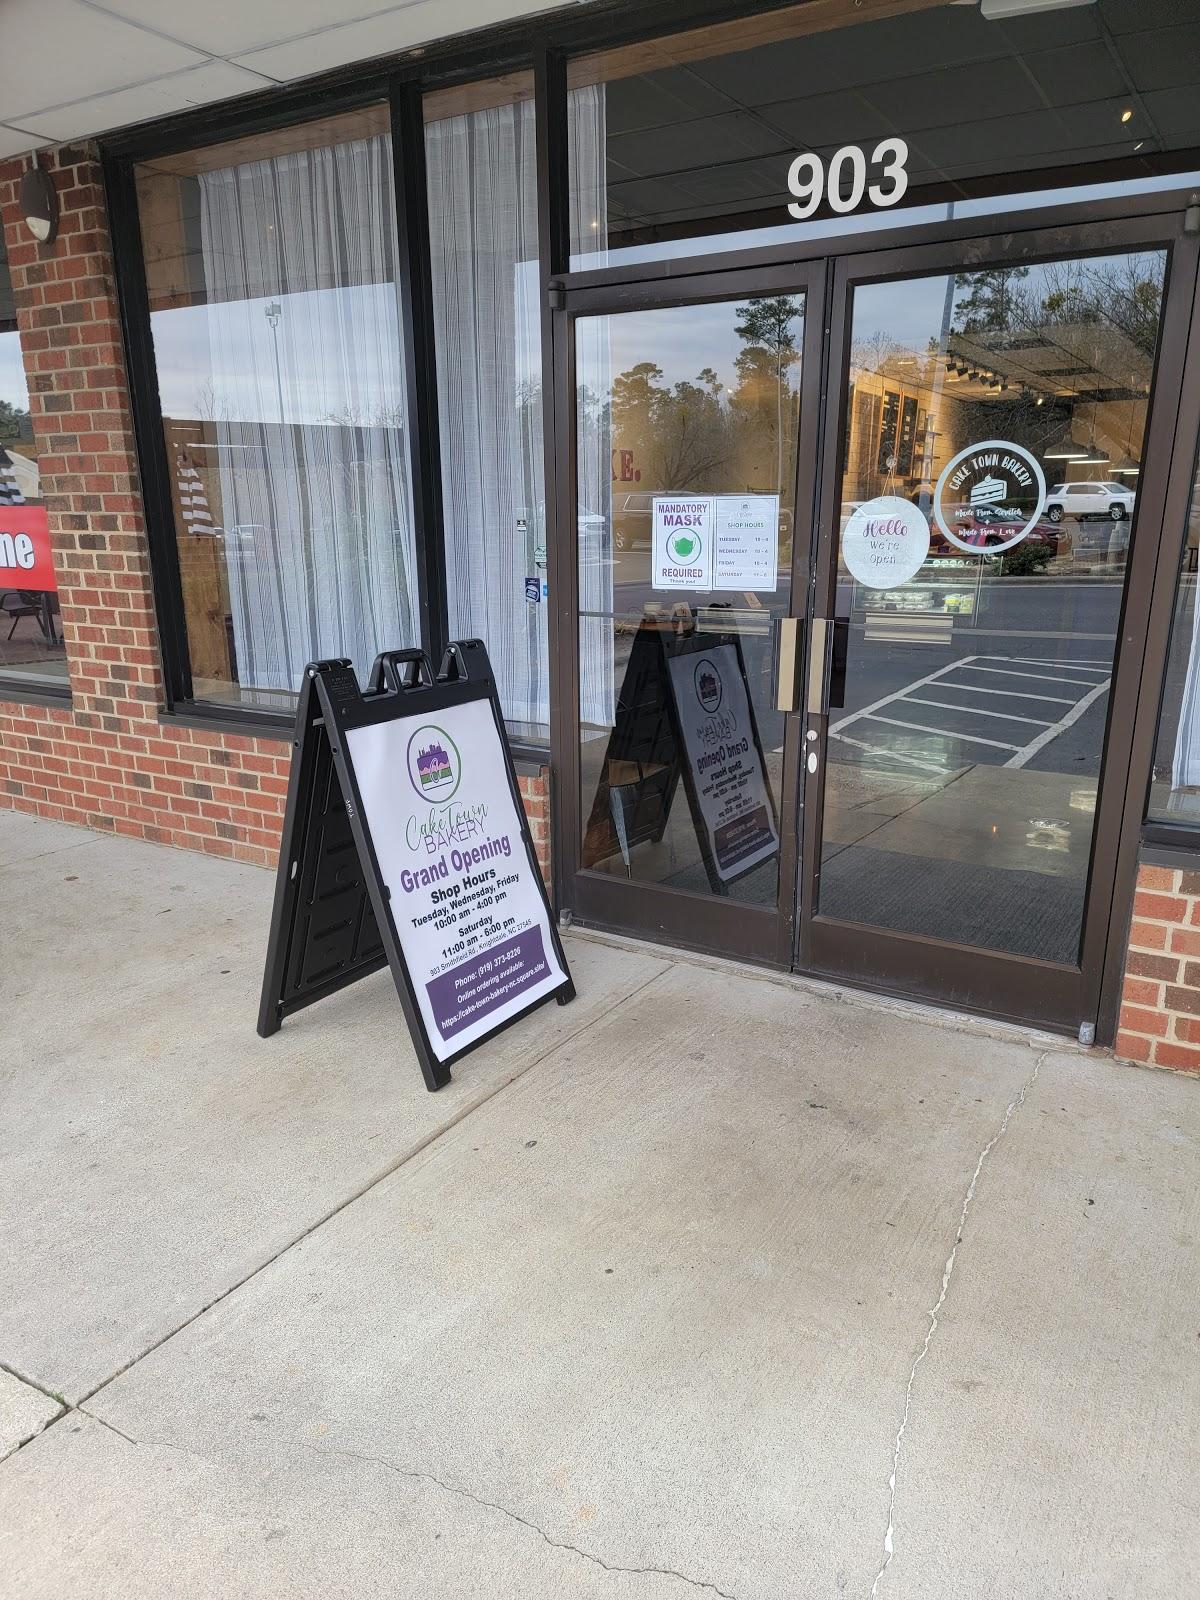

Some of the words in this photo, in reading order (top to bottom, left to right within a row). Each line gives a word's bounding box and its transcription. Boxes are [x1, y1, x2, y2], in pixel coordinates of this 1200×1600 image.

[787, 137, 909, 219] 903
[949, 464, 972, 491] CAKE
[971, 454, 999, 470] TOWN
[1001, 456, 1033, 487] BAKERY
[658, 503, 708, 514] MANDATORY
[663, 514, 703, 526] MASK
[862, 520, 908, 538] Hello
[662, 568, 703, 578] REQUIRED
[405, 807, 448, 851] Cake
[440, 801, 489, 835] Town
[424, 815, 486, 854] BAKERY
[400, 854, 450, 894] Grand
[450, 835, 512, 873] Opening
[411, 905, 450, 929] Tuesday,
[449, 883, 496, 910] Wednesday,
[496, 872, 520, 890] Friday
[430, 882, 461, 905] Shop
[462, 868, 497, 890] Hours
[434, 913, 457, 931] 10:00
[459, 907, 471, 919] am
[476, 896, 493, 910] 4:00
[494, 890, 507, 904] pm
[458, 915, 493, 937] Saturday
[430, 966, 440, 977] 903
[440, 952, 468, 971] Smithfield
[508, 926, 516, 934] NC
[442, 940, 465, 958] 11:00
[466, 936, 478, 946] am
[484, 922, 502, 937] 6:00
[502, 917, 516, 930] pm
[454, 972, 478, 990] Phone:
[478, 962, 494, 980] (919)
[457, 989, 476, 1004] Online
[476, 975, 500, 993] ordering
[500, 960, 525, 979] available:
